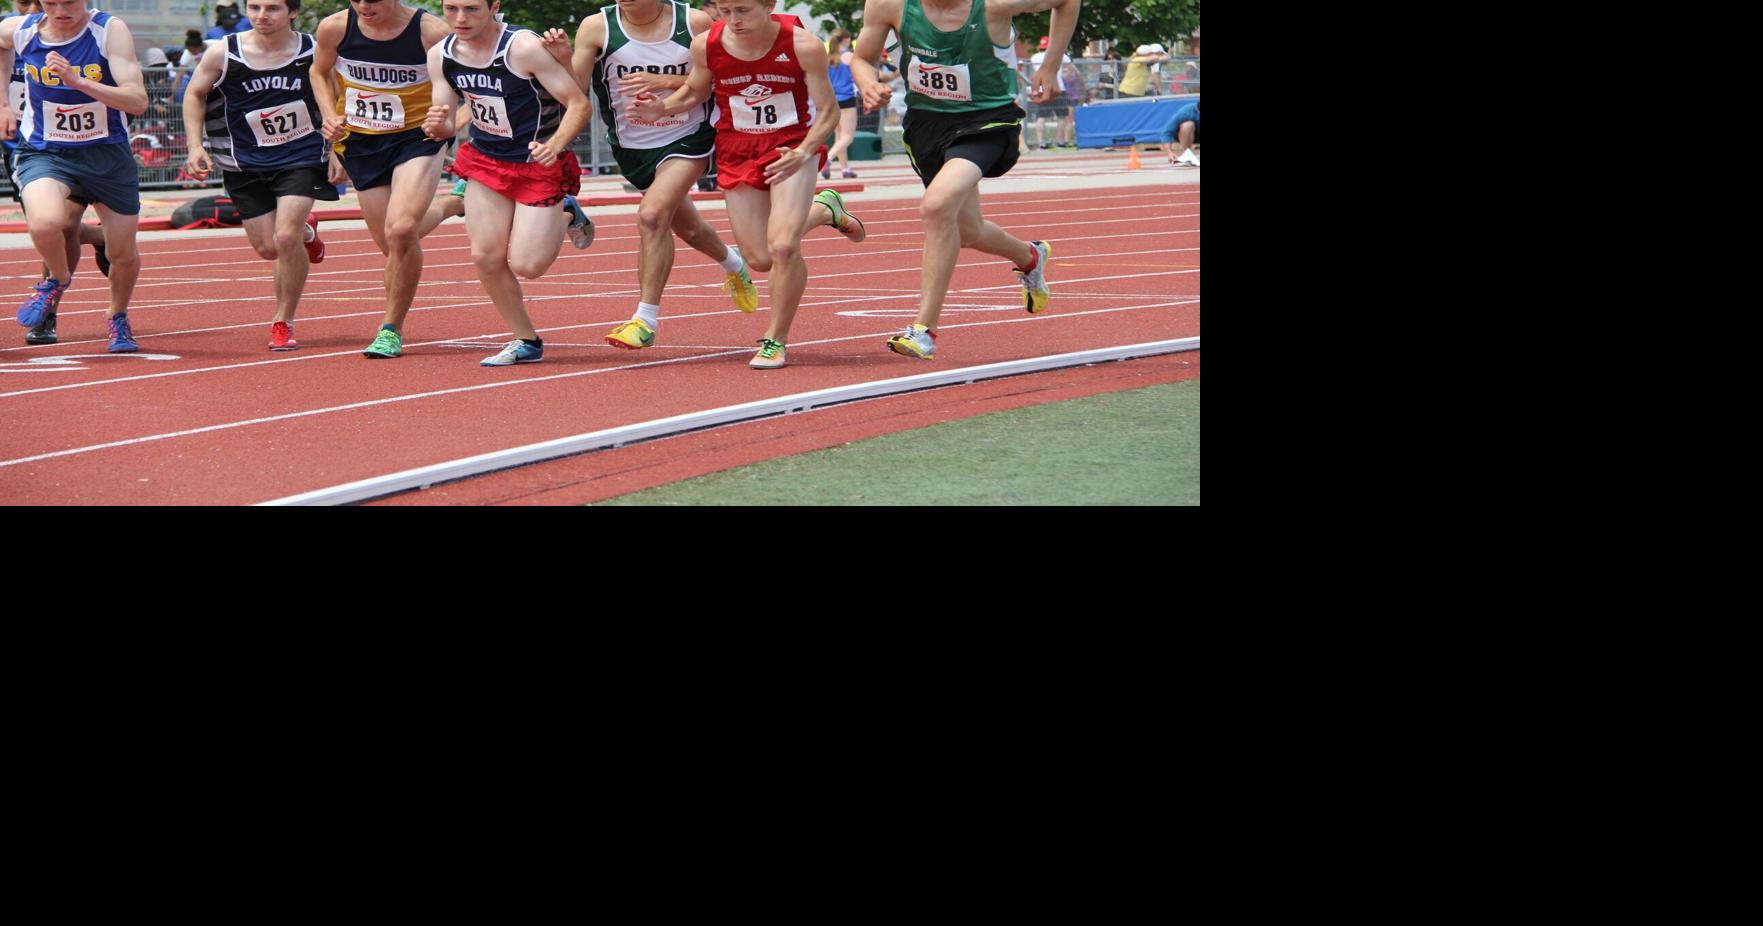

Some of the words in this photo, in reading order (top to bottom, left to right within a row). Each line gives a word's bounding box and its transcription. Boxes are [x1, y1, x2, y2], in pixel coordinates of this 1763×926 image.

[347, 64, 418, 83] BULLDOGS
[456, 74, 503, 92] OYOLA
[919, 69, 958, 91] 389
[242, 76, 302, 93] LOYOLA
[355, 99, 393, 122] 815
[752, 105, 778, 125] 78
[55, 112, 96, 132] 203
[261, 112, 298, 135] 627
